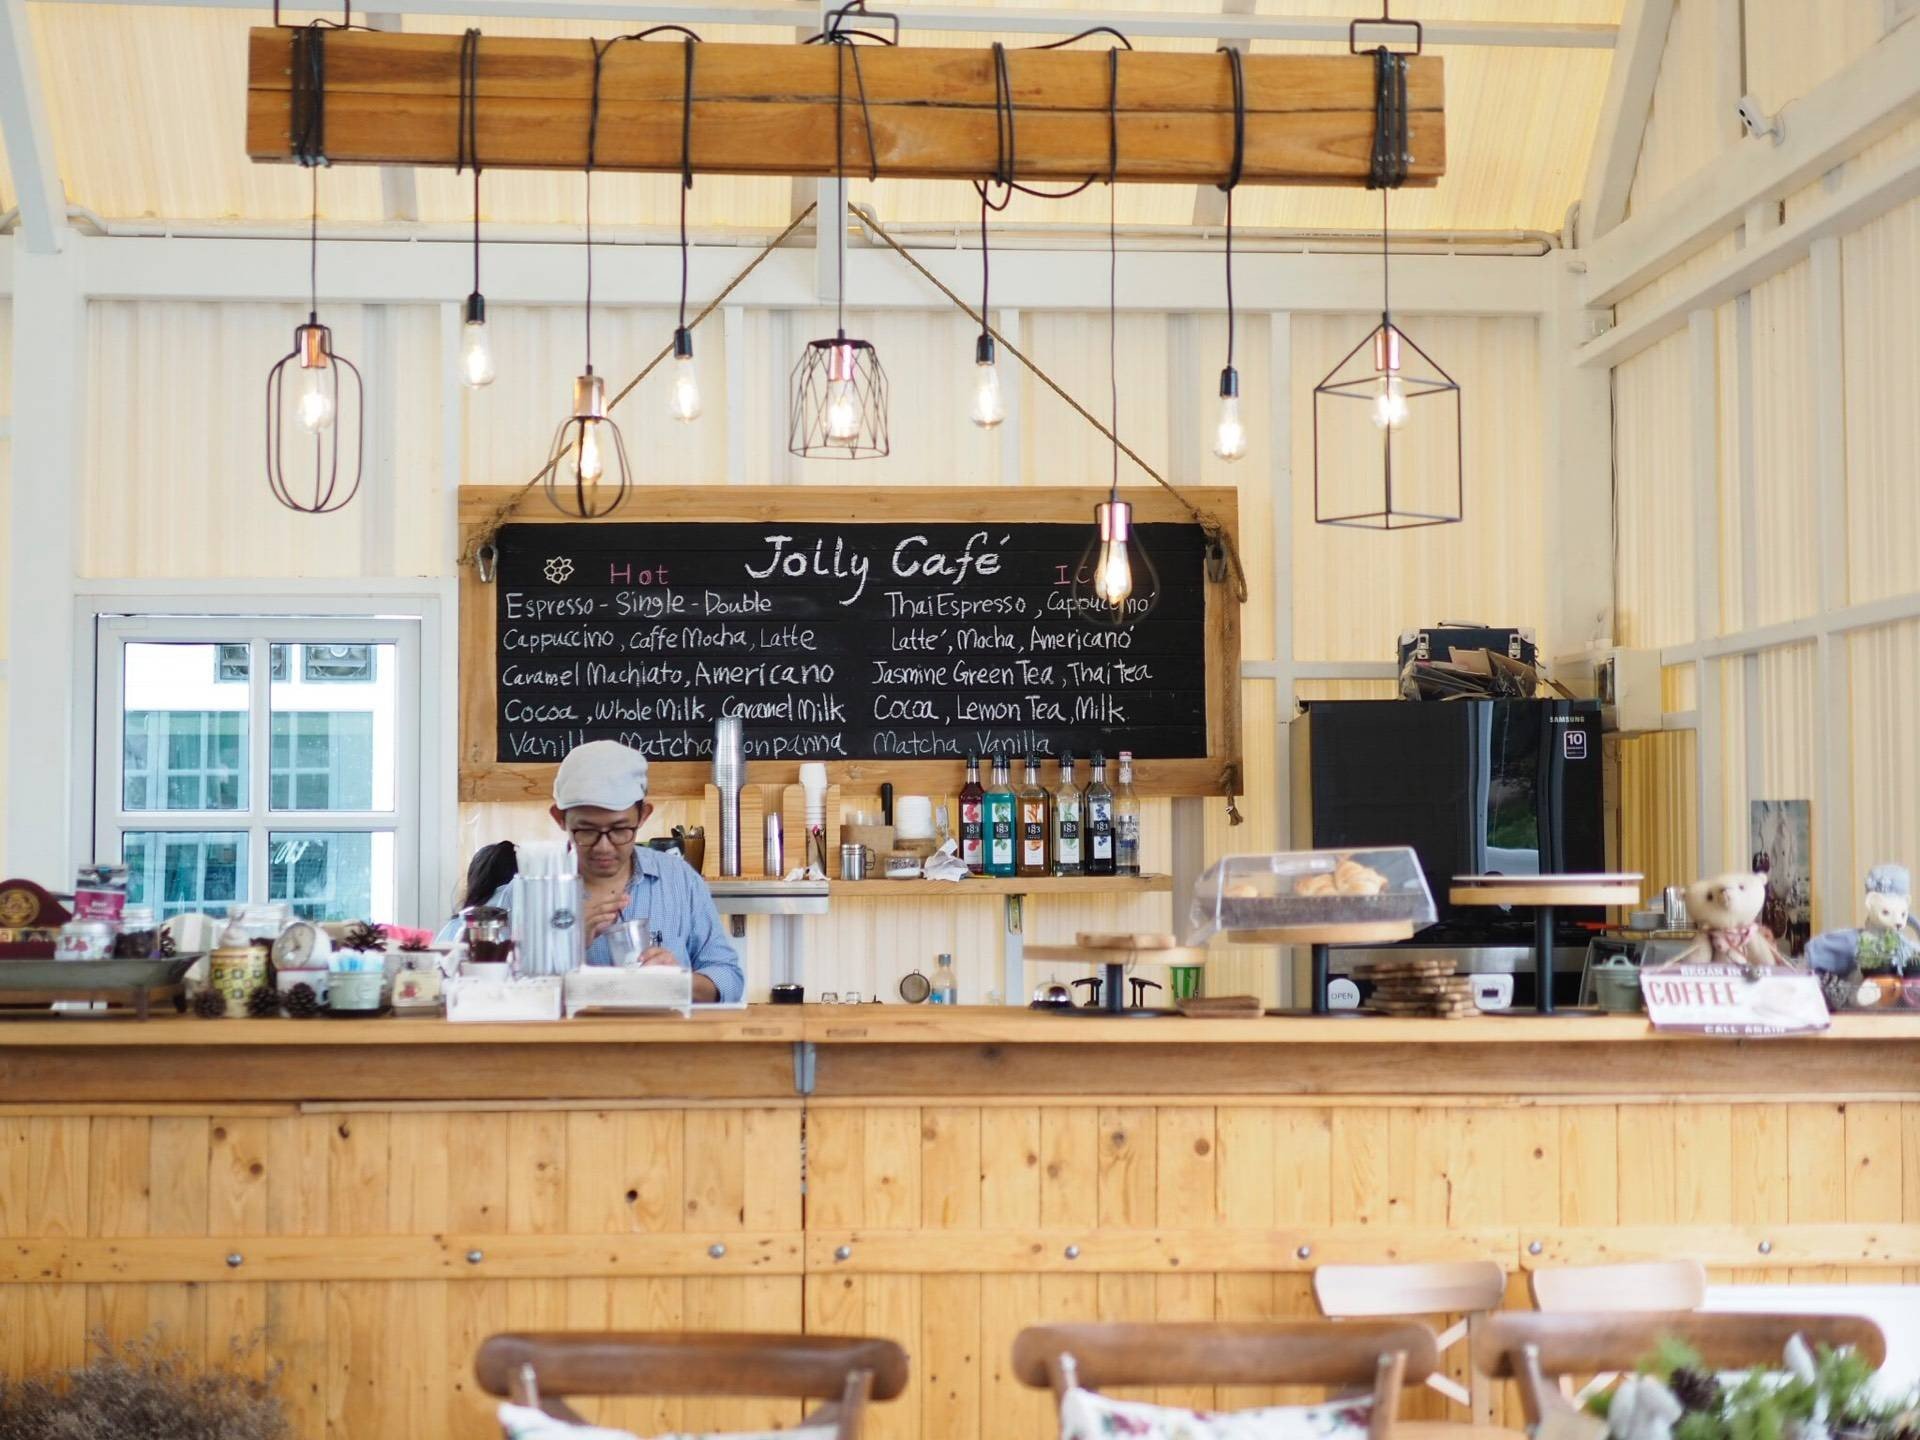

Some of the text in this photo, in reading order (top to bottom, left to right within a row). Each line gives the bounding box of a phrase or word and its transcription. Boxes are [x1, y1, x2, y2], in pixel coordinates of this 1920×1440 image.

[610, 563, 669, 585] Hot
[744, 531, 1010, 606] Jolly Café
[507, 593, 593, 620] Espresso
[616, 588, 685, 618] Single
[705, 590, 772, 613] Double
[884, 591, 933, 618] Thai
[760, 624, 816, 651] Latte
[503, 662, 579, 687] Caramel
[695, 662, 834, 687] Americano
[871, 661, 953, 685] Jasmine
[953, 660, 1014, 686] Green
[1068, 663, 1111, 685] Thai
[595, 703, 652, 721] Whole
[721, 693, 793, 720] Caramel
[798, 693, 846, 723] Milk
[957, 694, 1021, 721] Lemon
[509, 729, 584, 757] Vanill
[744, 732, 847, 759] onpanna
[976, 729, 1054, 756] Vanilla
[1567, 733, 1583, 745] 10
[1330, 992, 1354, 1000] OPEN
[1649, 981, 1740, 1006] COFFEE
